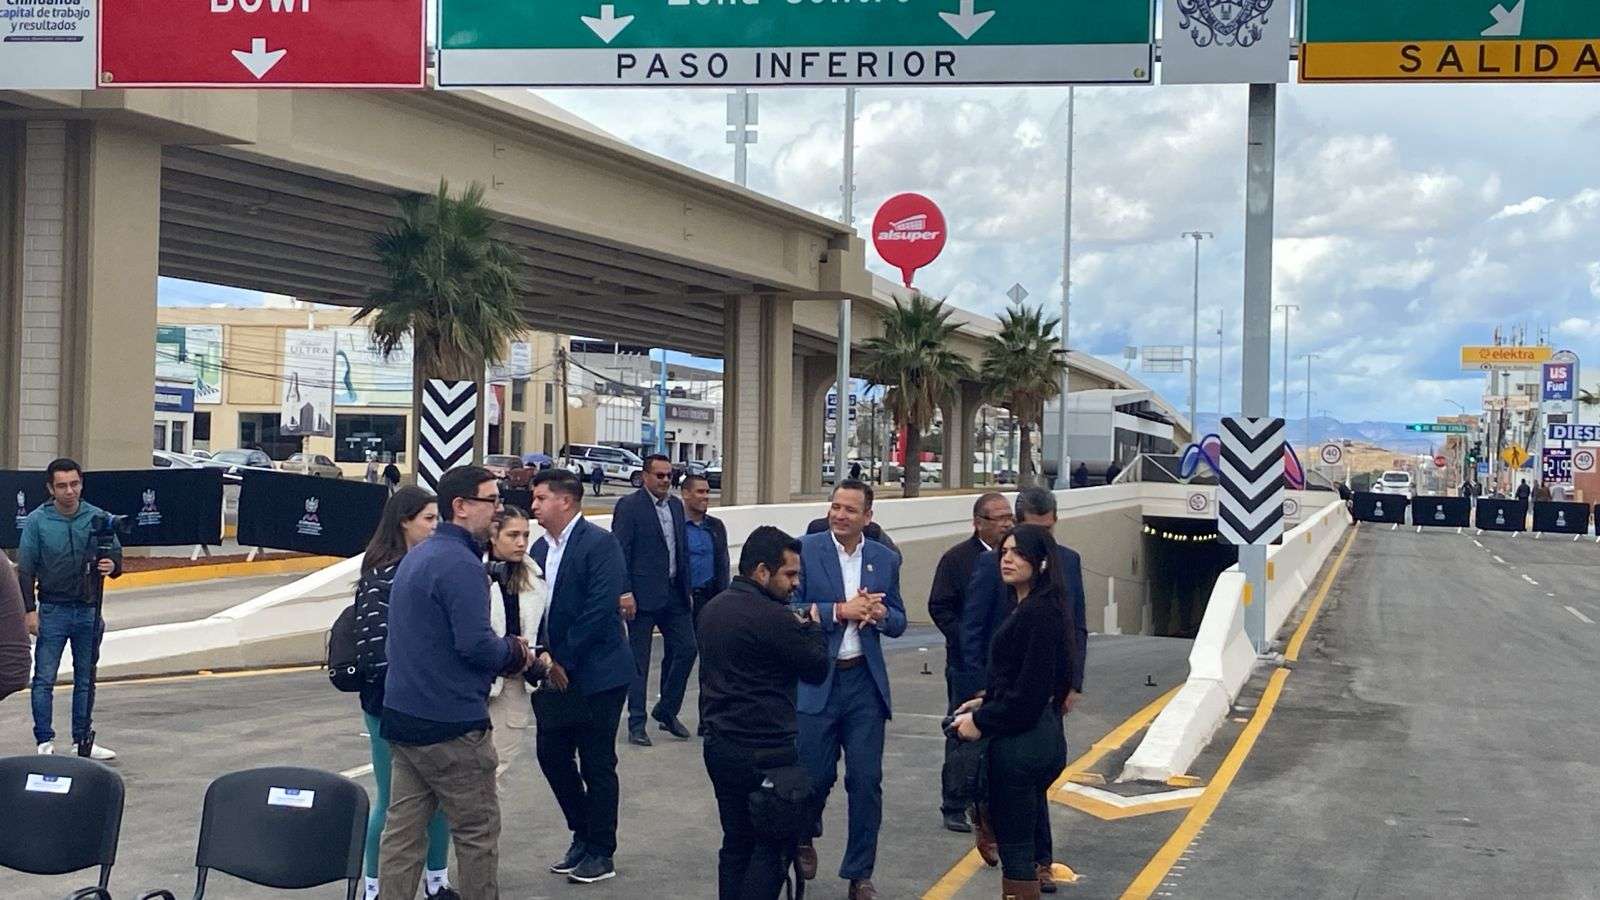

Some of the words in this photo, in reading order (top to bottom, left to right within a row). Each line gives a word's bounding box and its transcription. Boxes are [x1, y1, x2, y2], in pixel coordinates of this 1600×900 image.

[0, 8, 34, 20] capital
[36, 7, 50, 18] de
[52, 8, 90, 20] trabajo
[10, 22, 17, 33] y
[19, 20, 76, 31] resultados
[617, 53, 728, 78] PASO
[755, 51, 956, 77] INFERIOR
[1399, 44, 1600, 73] SALIDA
[878, 230, 940, 242] alsuper
[1492, 349, 1535, 360] elektra
[1549, 367, 1568, 379] US
[1546, 382, 1568, 392] Fuel
